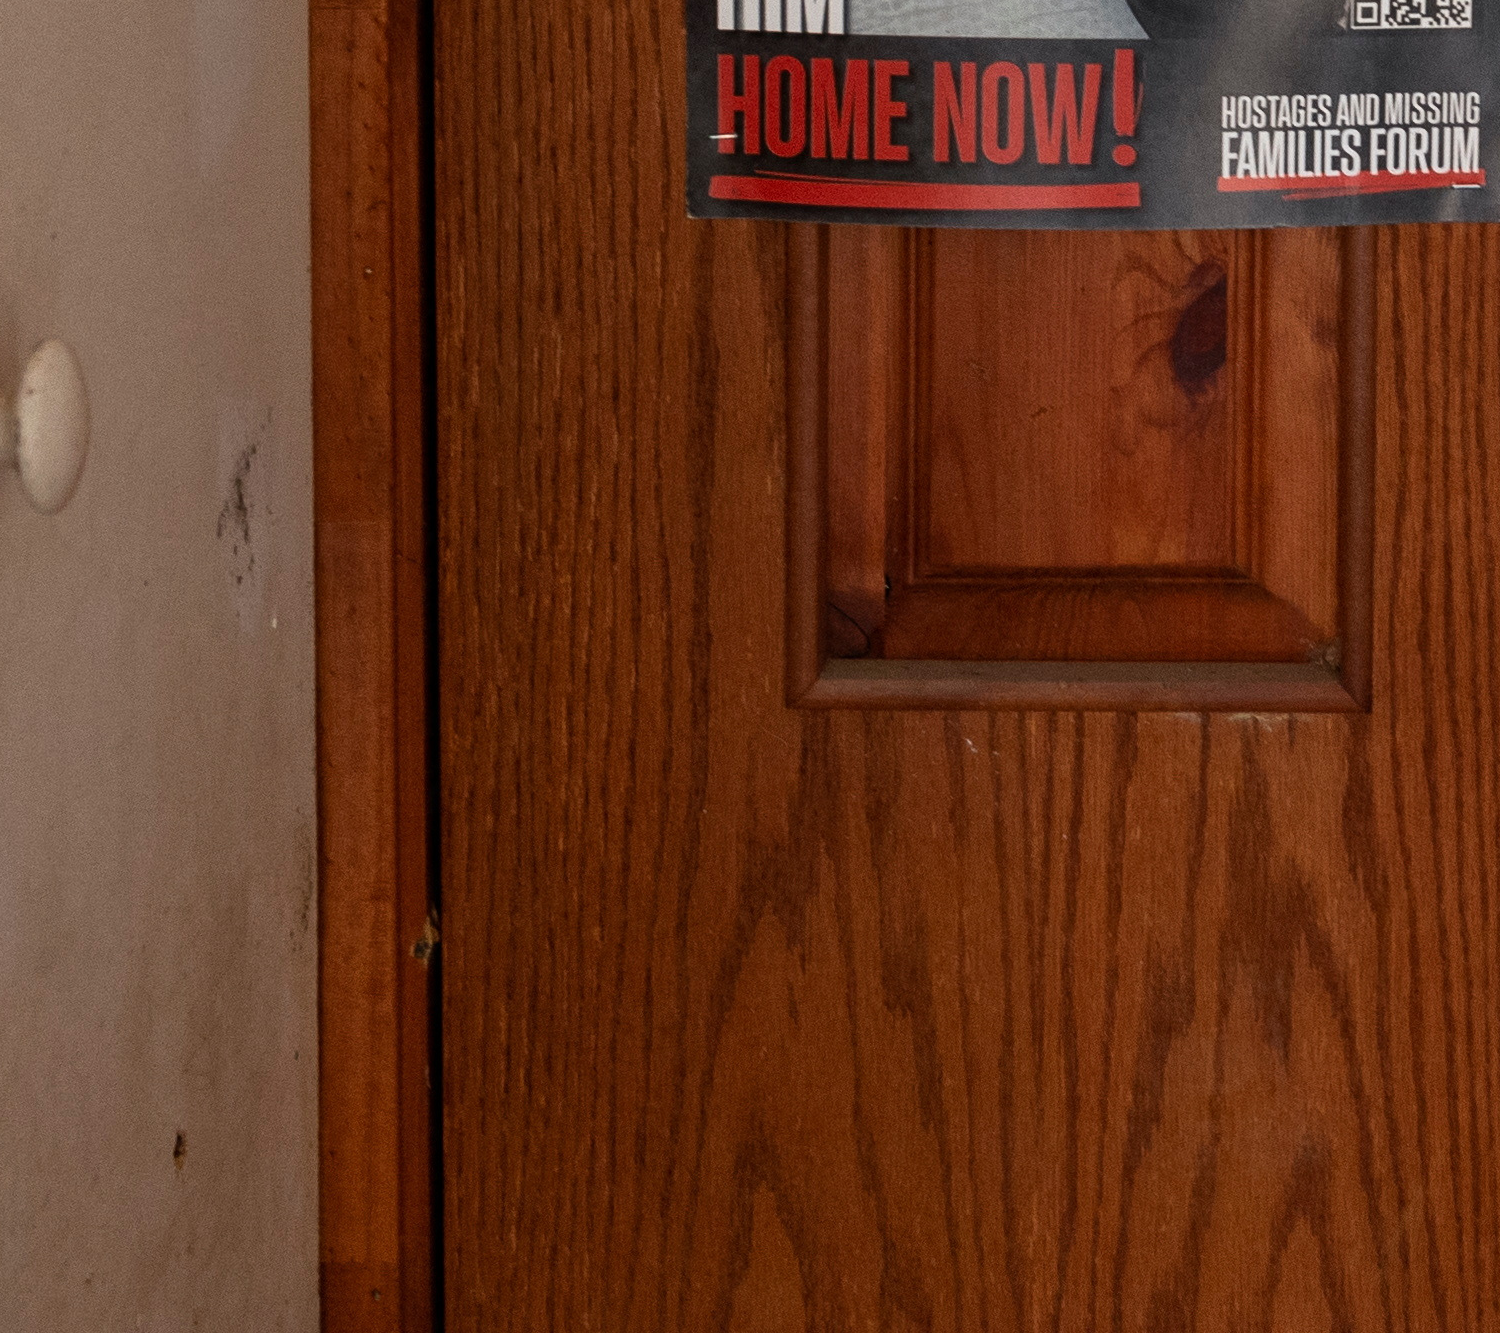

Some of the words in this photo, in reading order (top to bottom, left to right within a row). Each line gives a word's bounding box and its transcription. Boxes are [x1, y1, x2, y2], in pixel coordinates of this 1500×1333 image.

[717, 54, 909, 161] HOME
[934, 49, 1137, 167] NOW!
[1221, 94, 1332, 129] HOSTAGES
[1335, 93, 1380, 126] AND
[1384, 91, 1480, 125] MISSING
[1221, 128, 1361, 179] FAMILIES
[1370, 126, 1480, 176] FORUM
